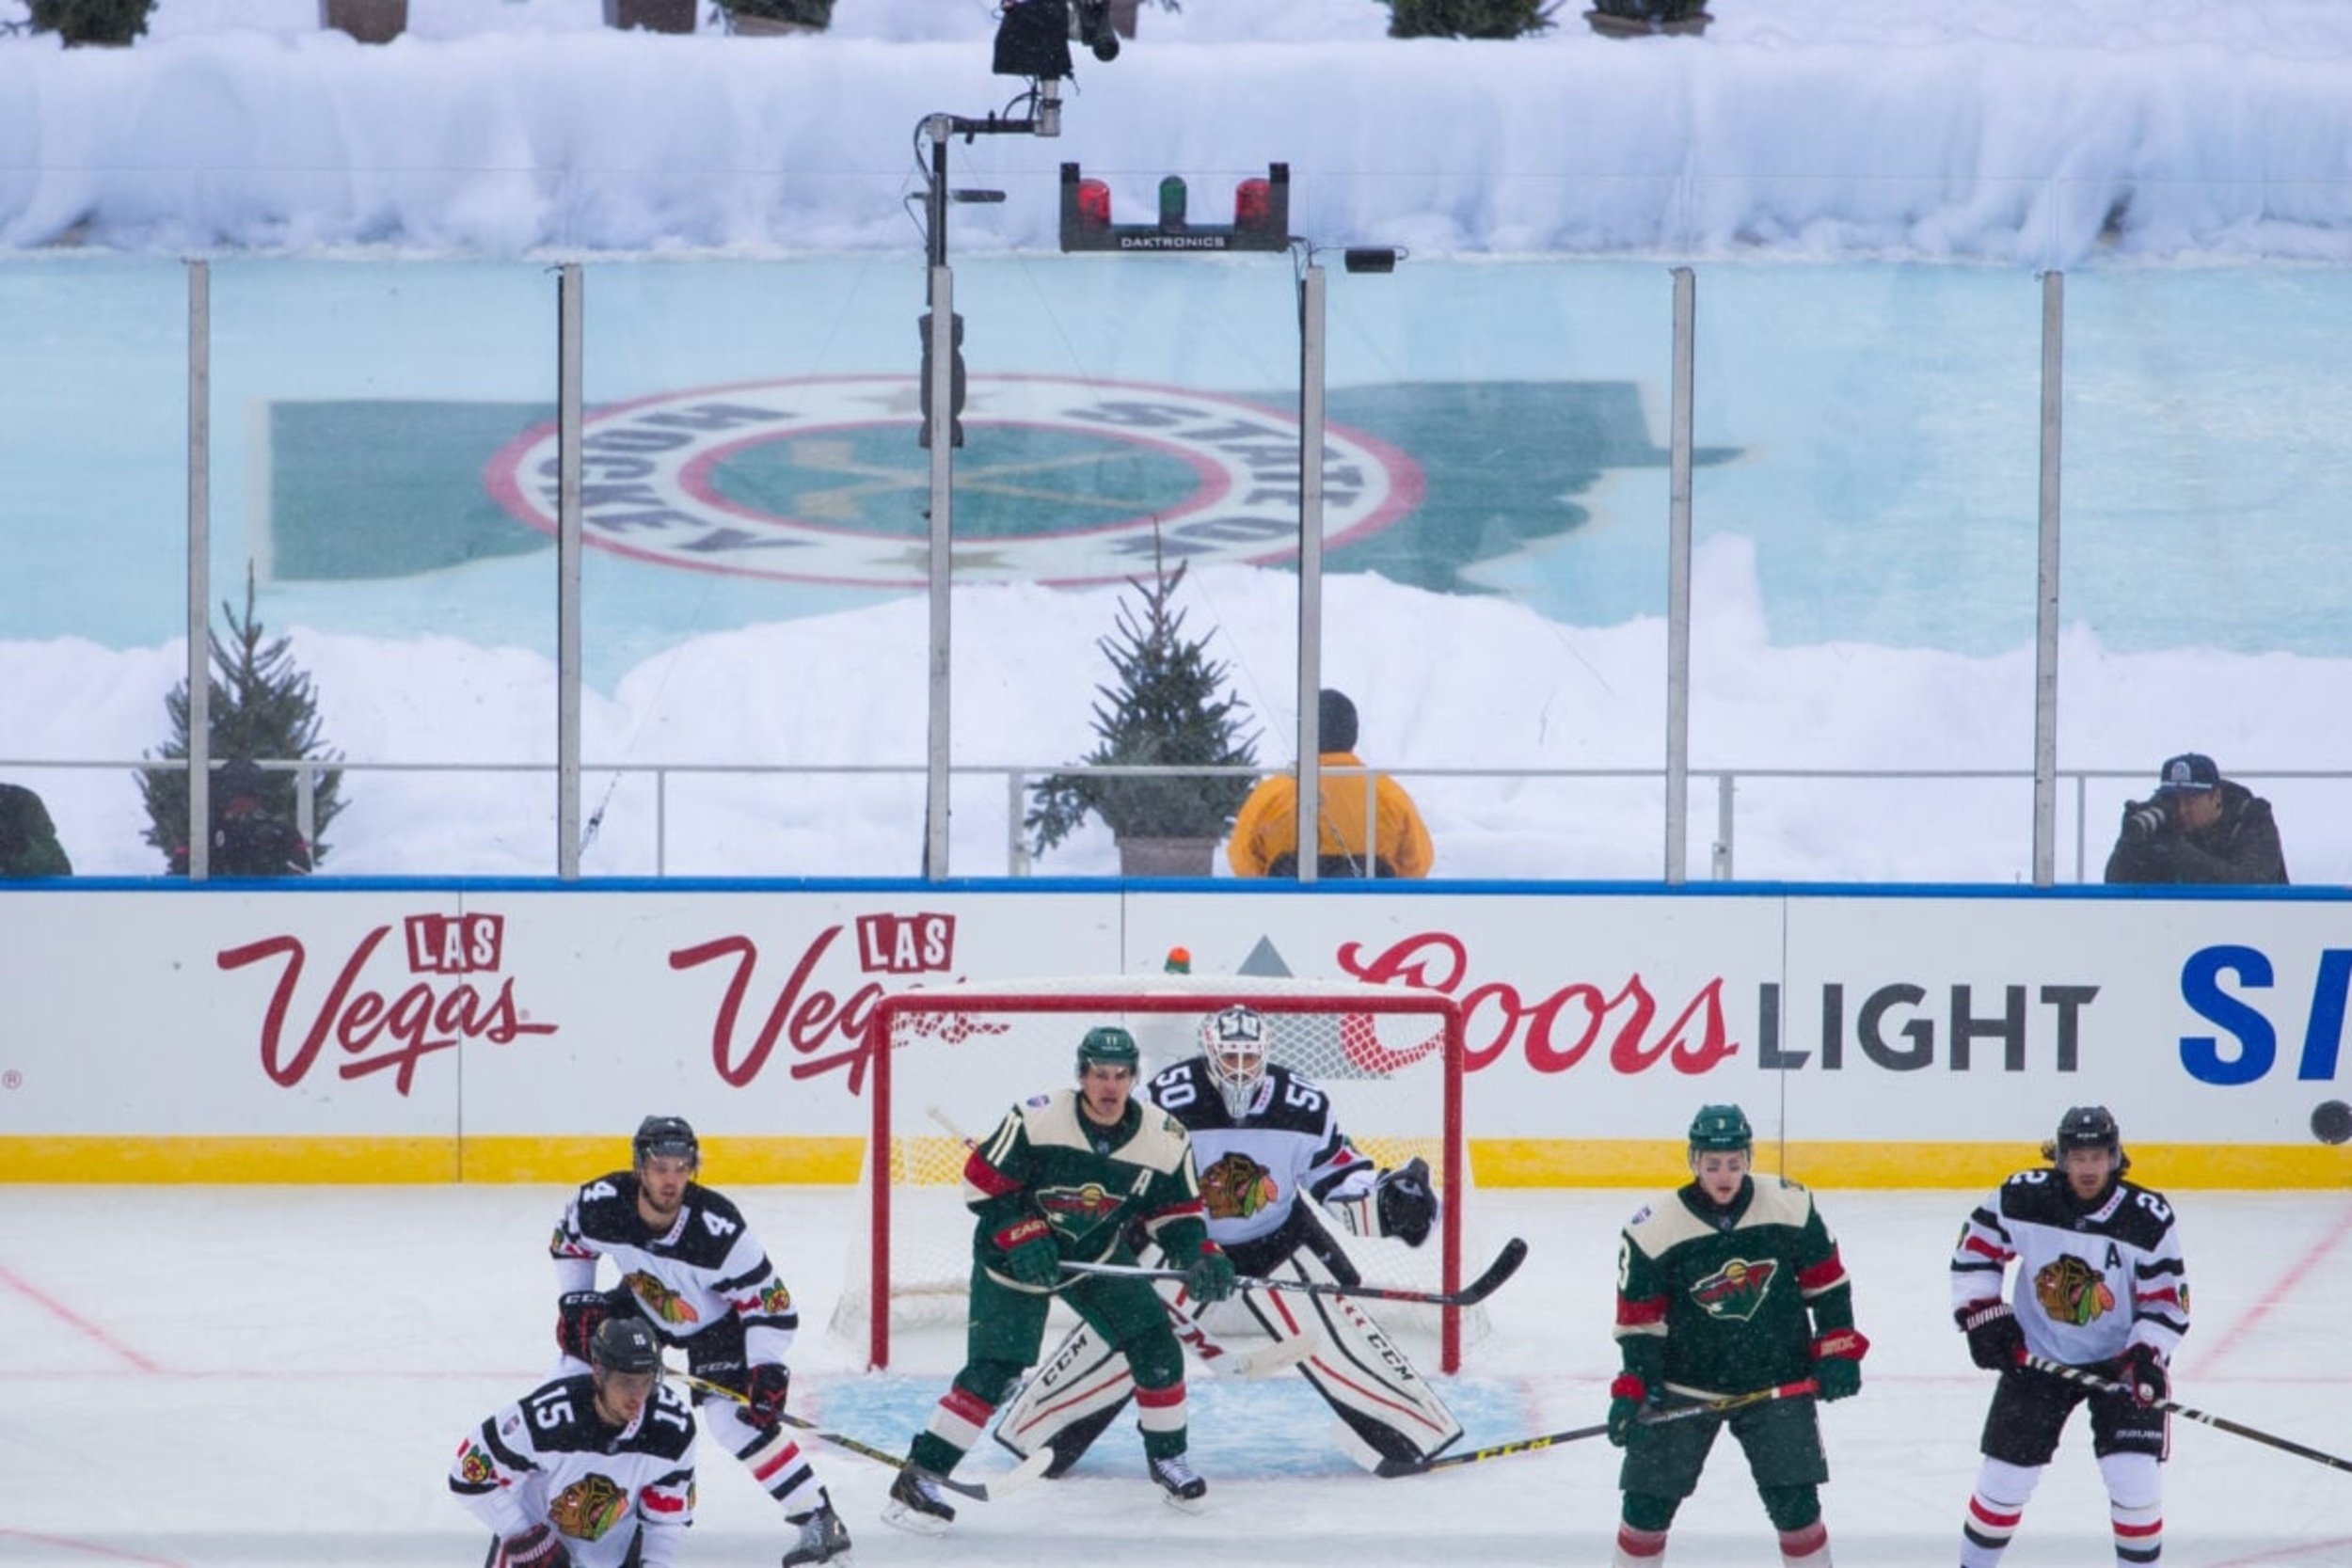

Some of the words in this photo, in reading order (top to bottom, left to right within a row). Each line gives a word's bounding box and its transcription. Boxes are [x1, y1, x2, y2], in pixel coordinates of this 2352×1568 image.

[1120, 237, 1225, 248] DAKTRONICS
[1059, 402, 1365, 508] STATE
[537, 402, 824, 553] HOCKEY
[411, 916, 499, 972] LAS
[863, 916, 950, 972] LAS
[216, 925, 560, 1098] Vegas
[1336, 931, 1740, 1075] Coors
[1756, 982, 2103, 1073] LIGHT
[1155, 1065, 1197, 1109] 50
[583, 1180, 618, 1203] 4
[1131, 1168, 1154, 1197] A
[2010, 1169, 2048, 1186] 2
[701, 1210, 738, 1238] 4
[2136, 1192, 2172, 1223] 2
[2105, 1243, 2122, 1271] A
[695, 1361, 742, 1375] CCM
[1041, 1334, 1089, 1387] CCM
[1367, 1332, 1415, 1382] CCM
[531, 1386, 577, 1430] 15
[654, 1383, 690, 1433] 15
